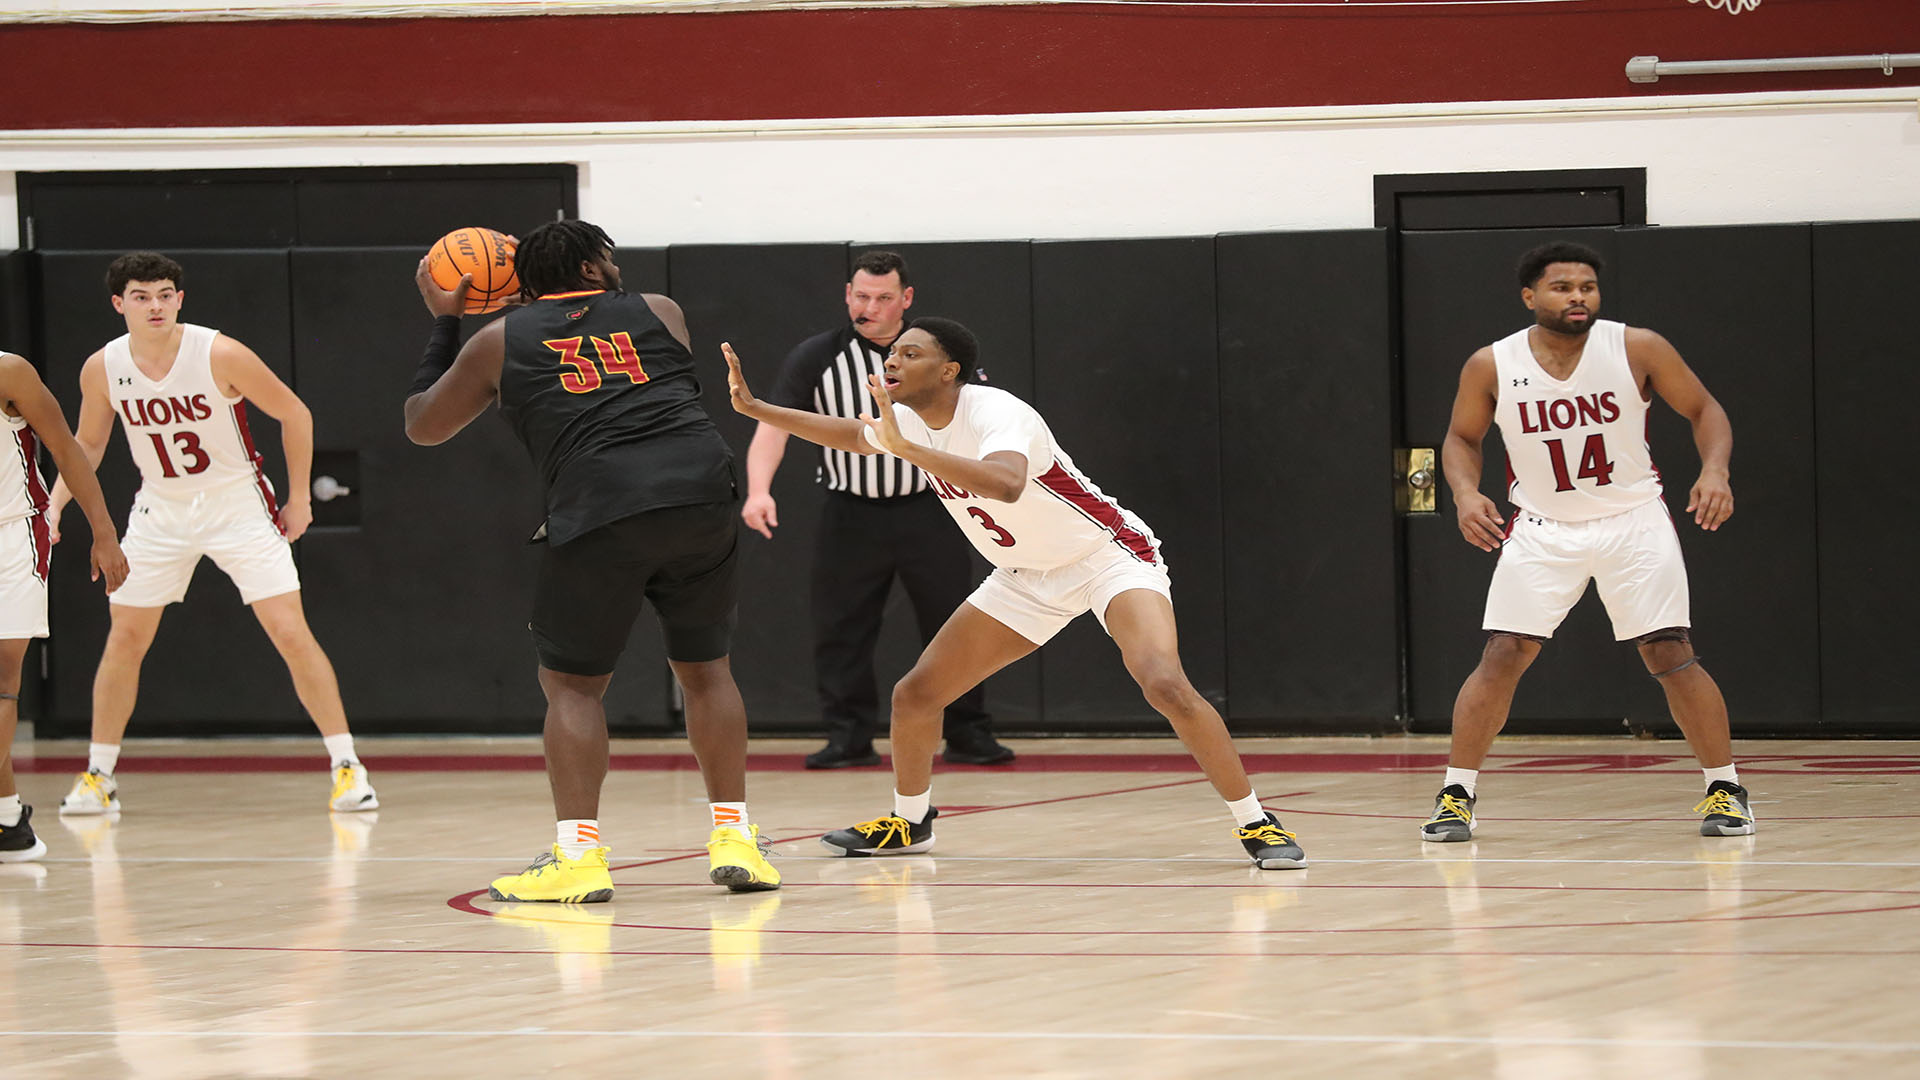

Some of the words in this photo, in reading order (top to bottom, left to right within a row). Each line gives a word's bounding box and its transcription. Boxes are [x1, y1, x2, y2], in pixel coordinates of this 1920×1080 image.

[542, 331, 650, 394] 34
[120, 393, 212, 427] LIONS
[1517, 391, 1621, 434] LIONS
[146, 431, 211, 479] 13
[1541, 432, 1615, 493] 14
[923, 470, 979, 500] LIO
[966, 506, 1016, 548] 3
